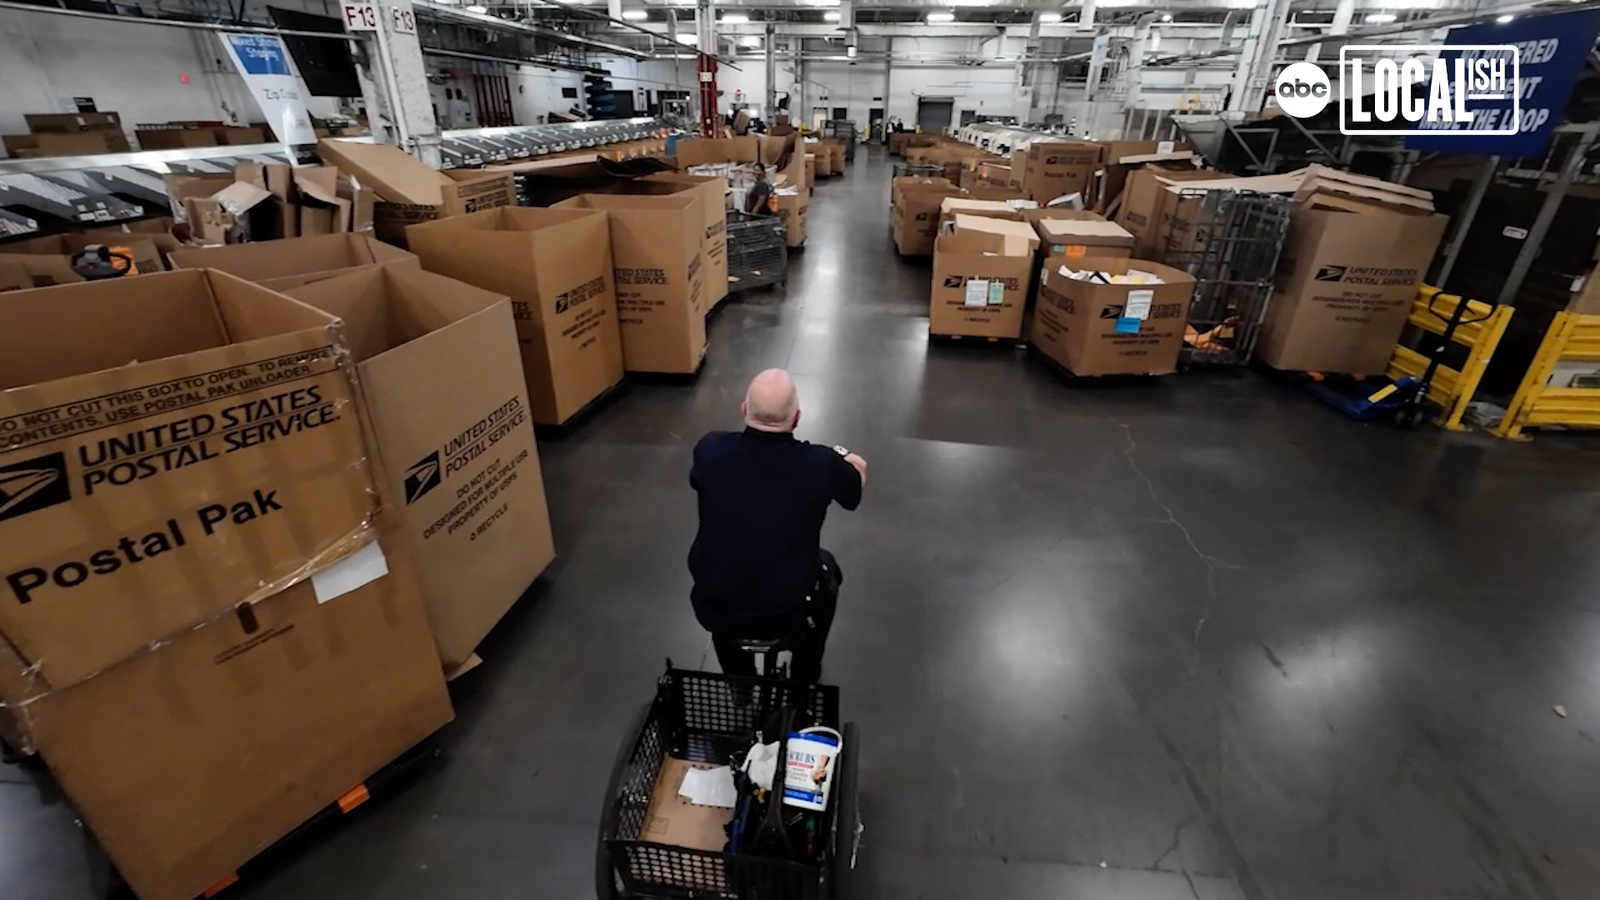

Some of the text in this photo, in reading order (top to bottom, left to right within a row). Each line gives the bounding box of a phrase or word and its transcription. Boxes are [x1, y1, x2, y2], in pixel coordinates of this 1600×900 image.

[345, 6, 375, 27] F13
[393, 9, 413, 30] F13
[1466, 109, 1500, 130] THE
[0, 419, 17, 433] O
[22, 409, 61, 427] NOT
[67, 401, 101, 416] CUT
[106, 391, 144, 408] THIS
[148, 382, 182, 398] BOX
[183, 378, 204, 389] TO
[258, 361, 275, 372] TO
[105, 405, 139, 422] USE
[144, 391, 206, 413] POSTAL
[207, 383, 237, 397] PAK
[79, 385, 322, 468] UNITED STATES
[444, 395, 520, 457] UNITED STATES
[83, 447, 219, 496] POSTAL
[446, 445, 487, 478] POSTAL
[457, 458, 501, 499] DO NOT CUT
[423, 501, 467, 539] DESIGNED
[468, 487, 483, 505] FOR
[447, 497, 489, 536] PROPERTY
[489, 487, 499, 500] OF
[476, 502, 509, 536] RECYCLE
[6, 489, 282, 604] Postal Pak
